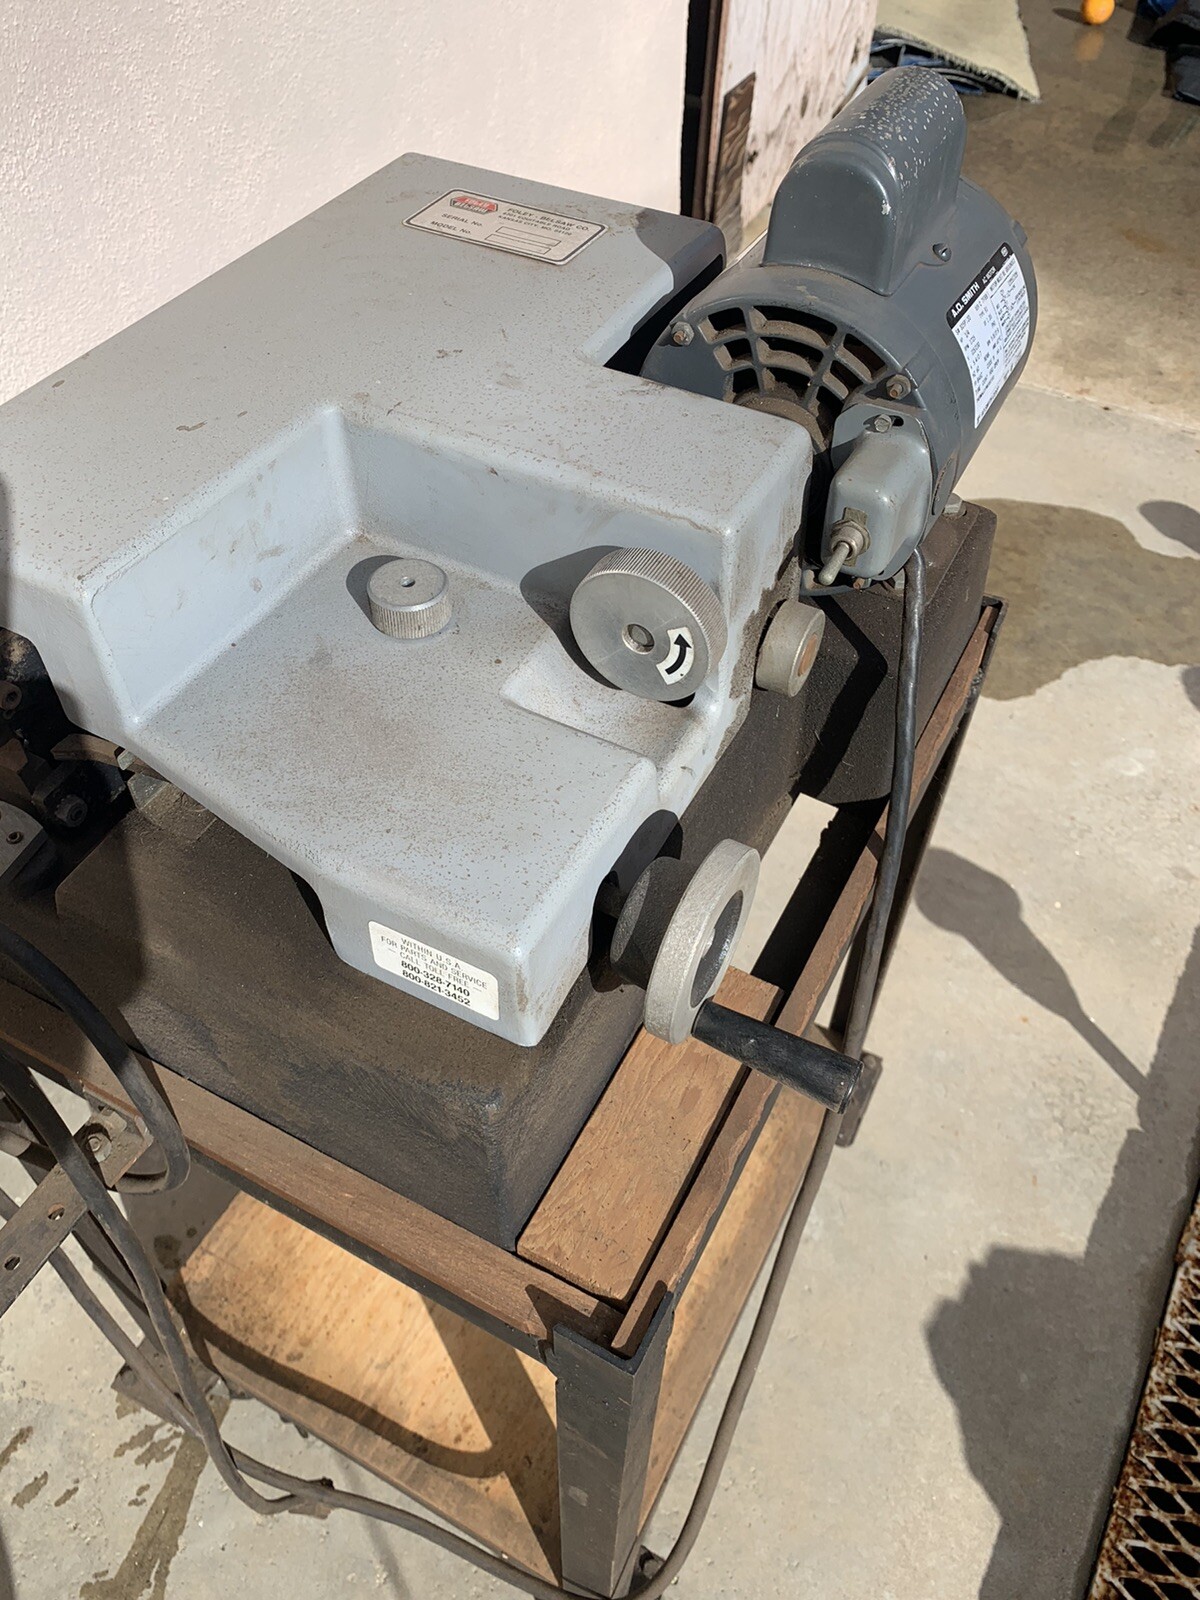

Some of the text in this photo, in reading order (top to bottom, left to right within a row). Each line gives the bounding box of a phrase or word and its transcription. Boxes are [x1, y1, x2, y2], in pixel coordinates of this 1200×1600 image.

[430, 222, 460, 231] MODEL
[441, 214, 472, 223] SERIAL
[498, 216, 524, 224] KANSAS
[507, 209, 534, 217] FOLEY
[539, 217, 576, 228] BELSAW
[951, 302, 964, 318] A.O.
[961, 281, 980, 306] SMITH
[402, 938, 433, 958] WITHIN
[381, 936, 488, 990] FOR PARTS AND SERVICE
[400, 952, 421, 967] CALL
[425, 963, 445, 977] TOLL
[448, 974, 470, 989] FREE
[401, 960, 471, 998] 800-328-7140
[402, 969, 471, 1007] 800-821-3452
